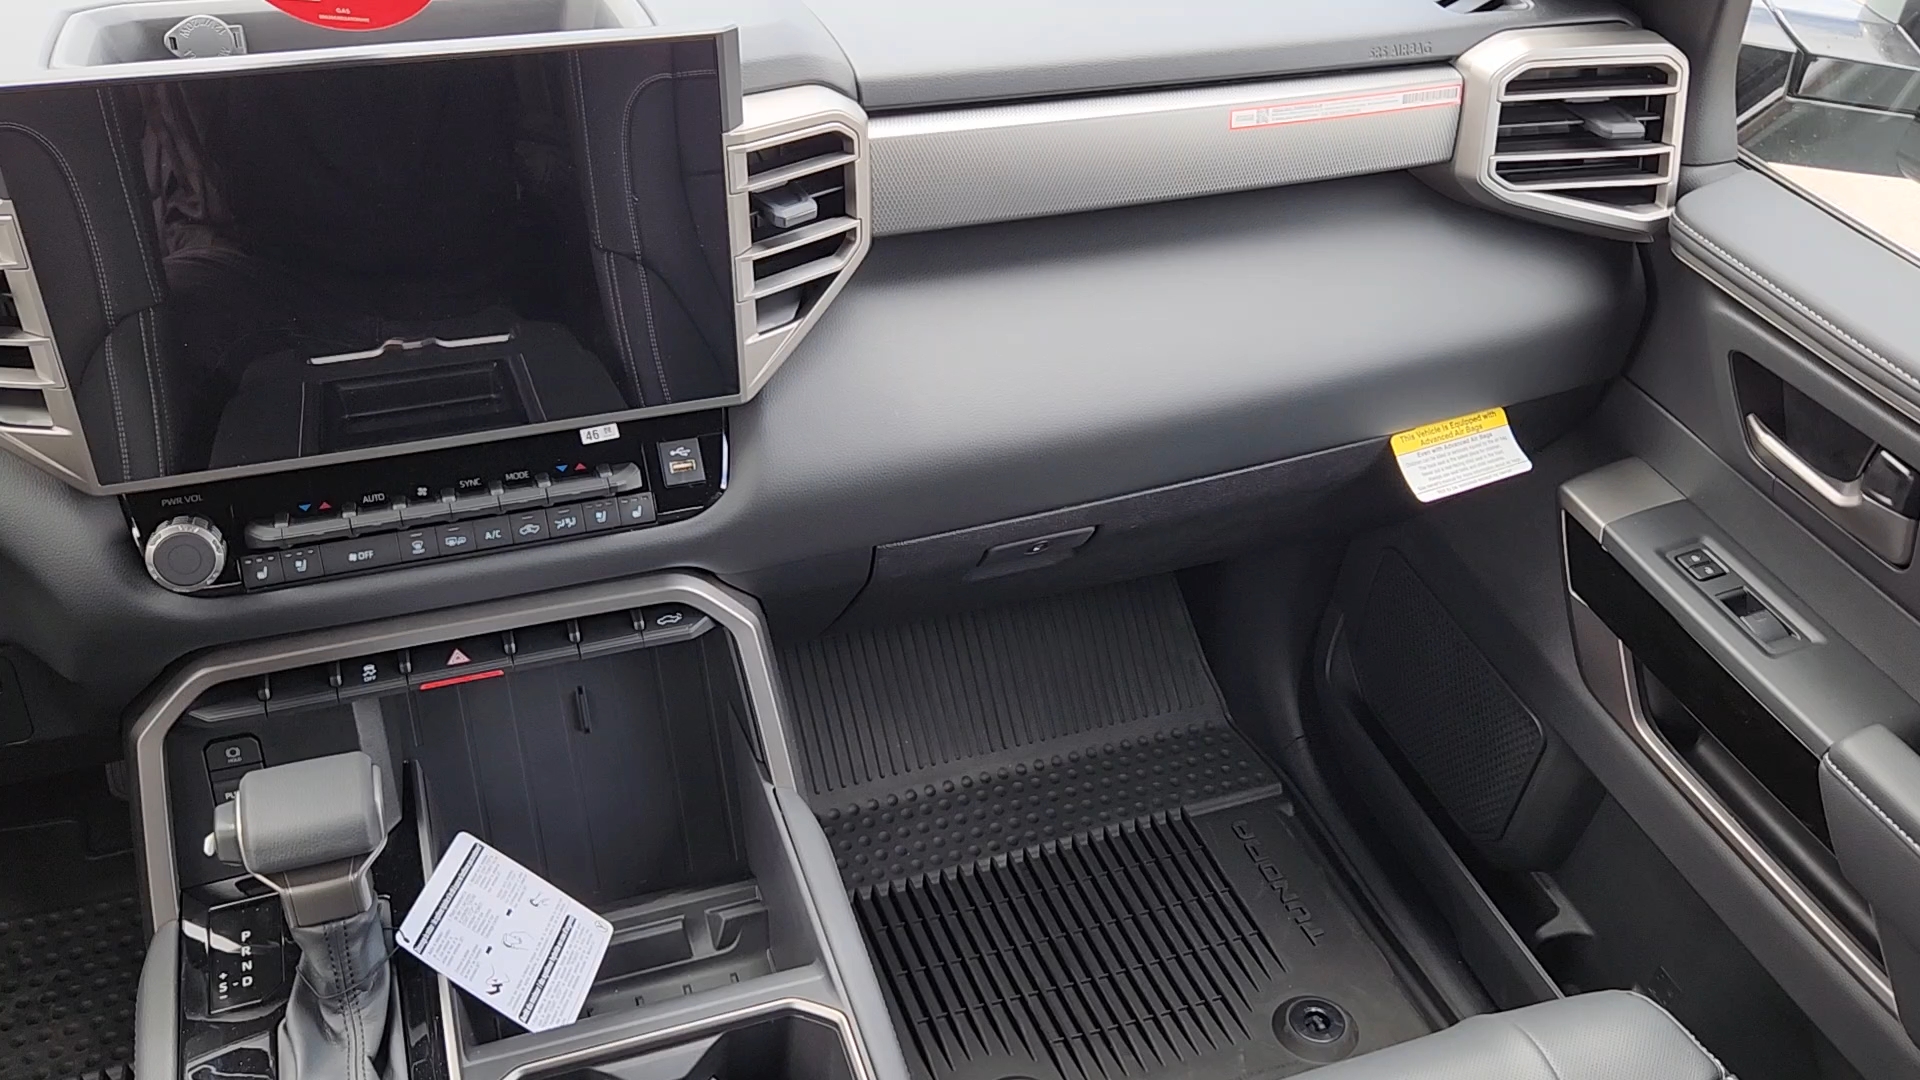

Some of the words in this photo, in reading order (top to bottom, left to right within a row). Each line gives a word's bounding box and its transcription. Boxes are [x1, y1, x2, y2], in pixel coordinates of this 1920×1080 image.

[1391, 41, 1433, 57] AIRBAG
[1399, 433, 1415, 444] This
[1416, 426, 1441, 438] Vehicle
[1449, 415, 1482, 430] Equipped
[1482, 411, 1497, 420] with
[1420, 433, 1454, 446] Advanced
[1455, 429, 1464, 437] Air
[1465, 424, 1483, 434] Bags
[505, 470, 530, 481] MODE
[459, 477, 482, 489] SYNC
[161, 497, 183, 508] PWR
[184, 494, 203, 504] VOL
[362, 492, 385, 504] AUTO
[485, 530, 502, 541] A/C
[358, 550, 374, 561] OFF
[363, 674, 377, 683] OFF
[241, 930, 252, 942] P
[241, 945, 252, 957] R
[241, 960, 253, 972] N
[218, 981, 228, 993] S
[242, 976, 253, 988] D
